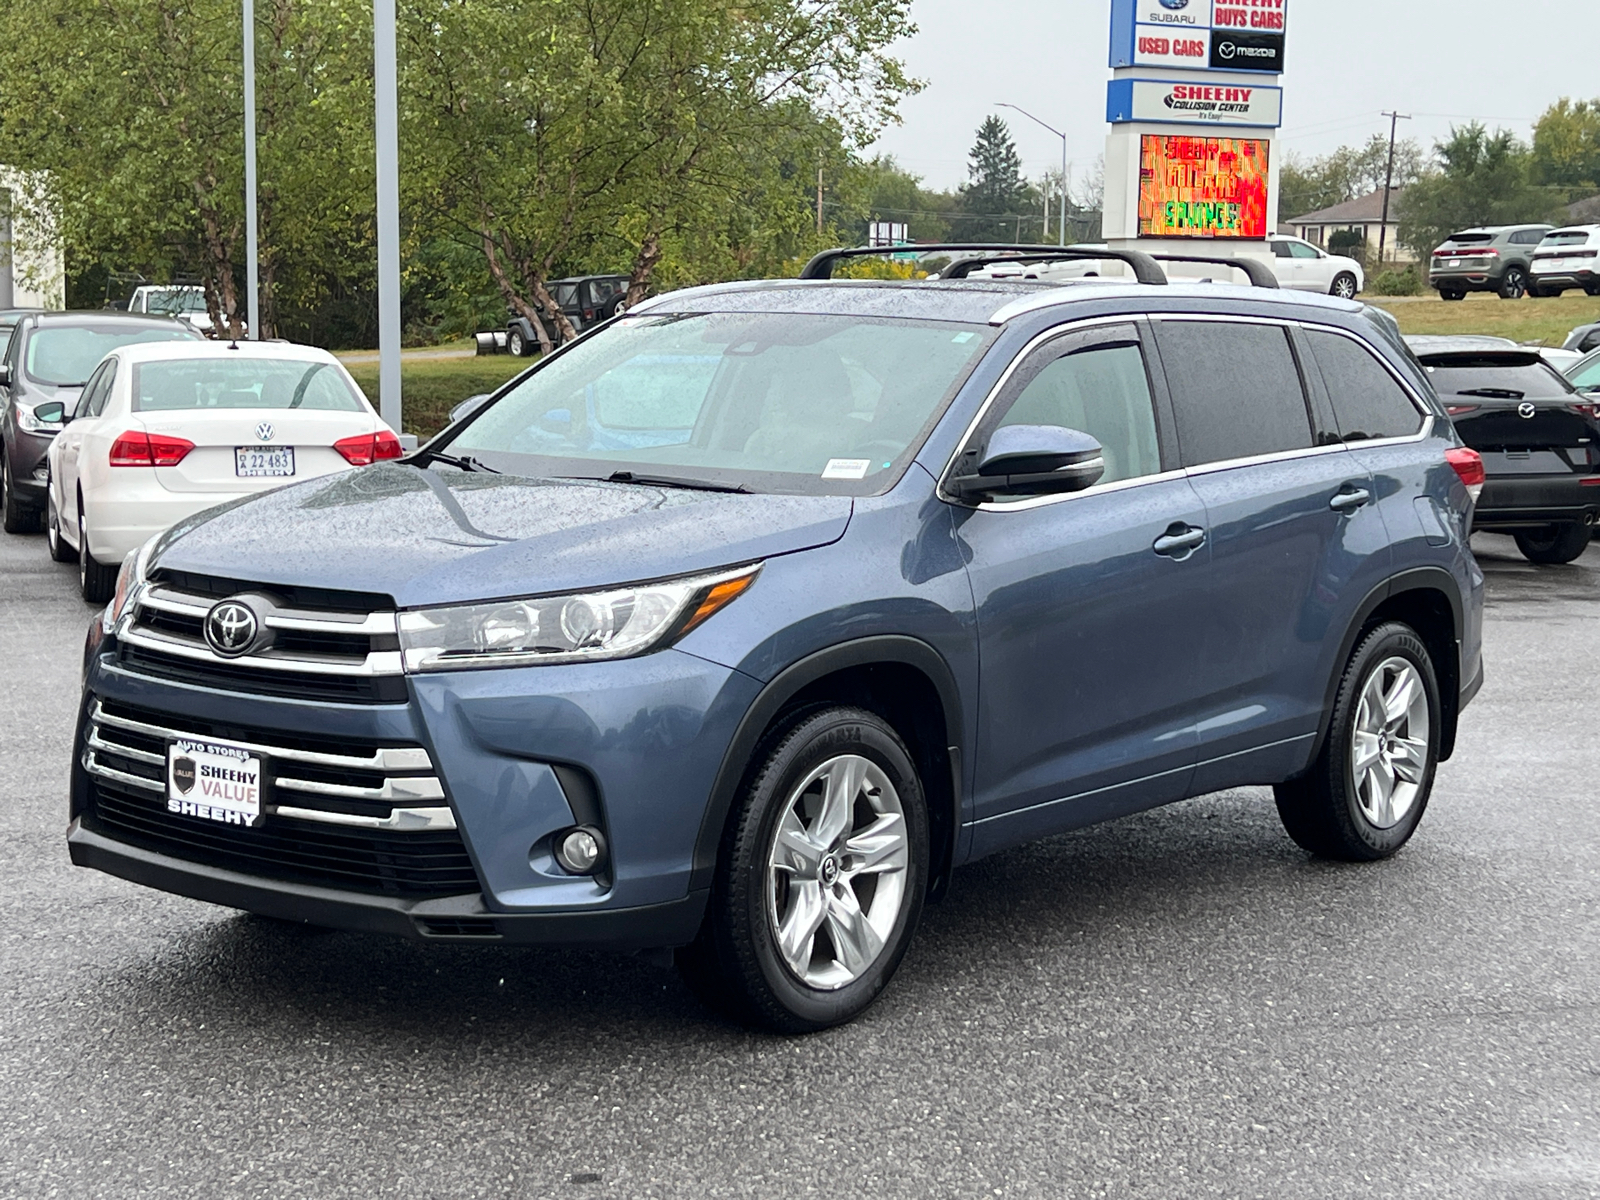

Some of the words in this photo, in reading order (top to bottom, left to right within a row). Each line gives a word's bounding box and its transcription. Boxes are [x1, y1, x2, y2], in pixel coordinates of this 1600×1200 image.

[1149, 13, 1196, 24] SUBARU
[1215, 8, 1247, 27] BUYS
[1251, 10, 1283, 29] CARS
[1138, 36, 1170, 55] USED
[1173, 39, 1204, 57] CARS
[1236, 46, 1276, 58] mazda
[1173, 85, 1252, 102] SHEEHY
[1173, 101, 1217, 111] COLLISION
[1218, 103, 1250, 112] CENTER
[176, 740, 205, 752] AUTO
[207, 745, 250, 760] STORES
[201, 764, 257, 785] SHEEHY
[201, 779, 257, 804] VALUE
[168, 799, 259, 827] SHEEHY
